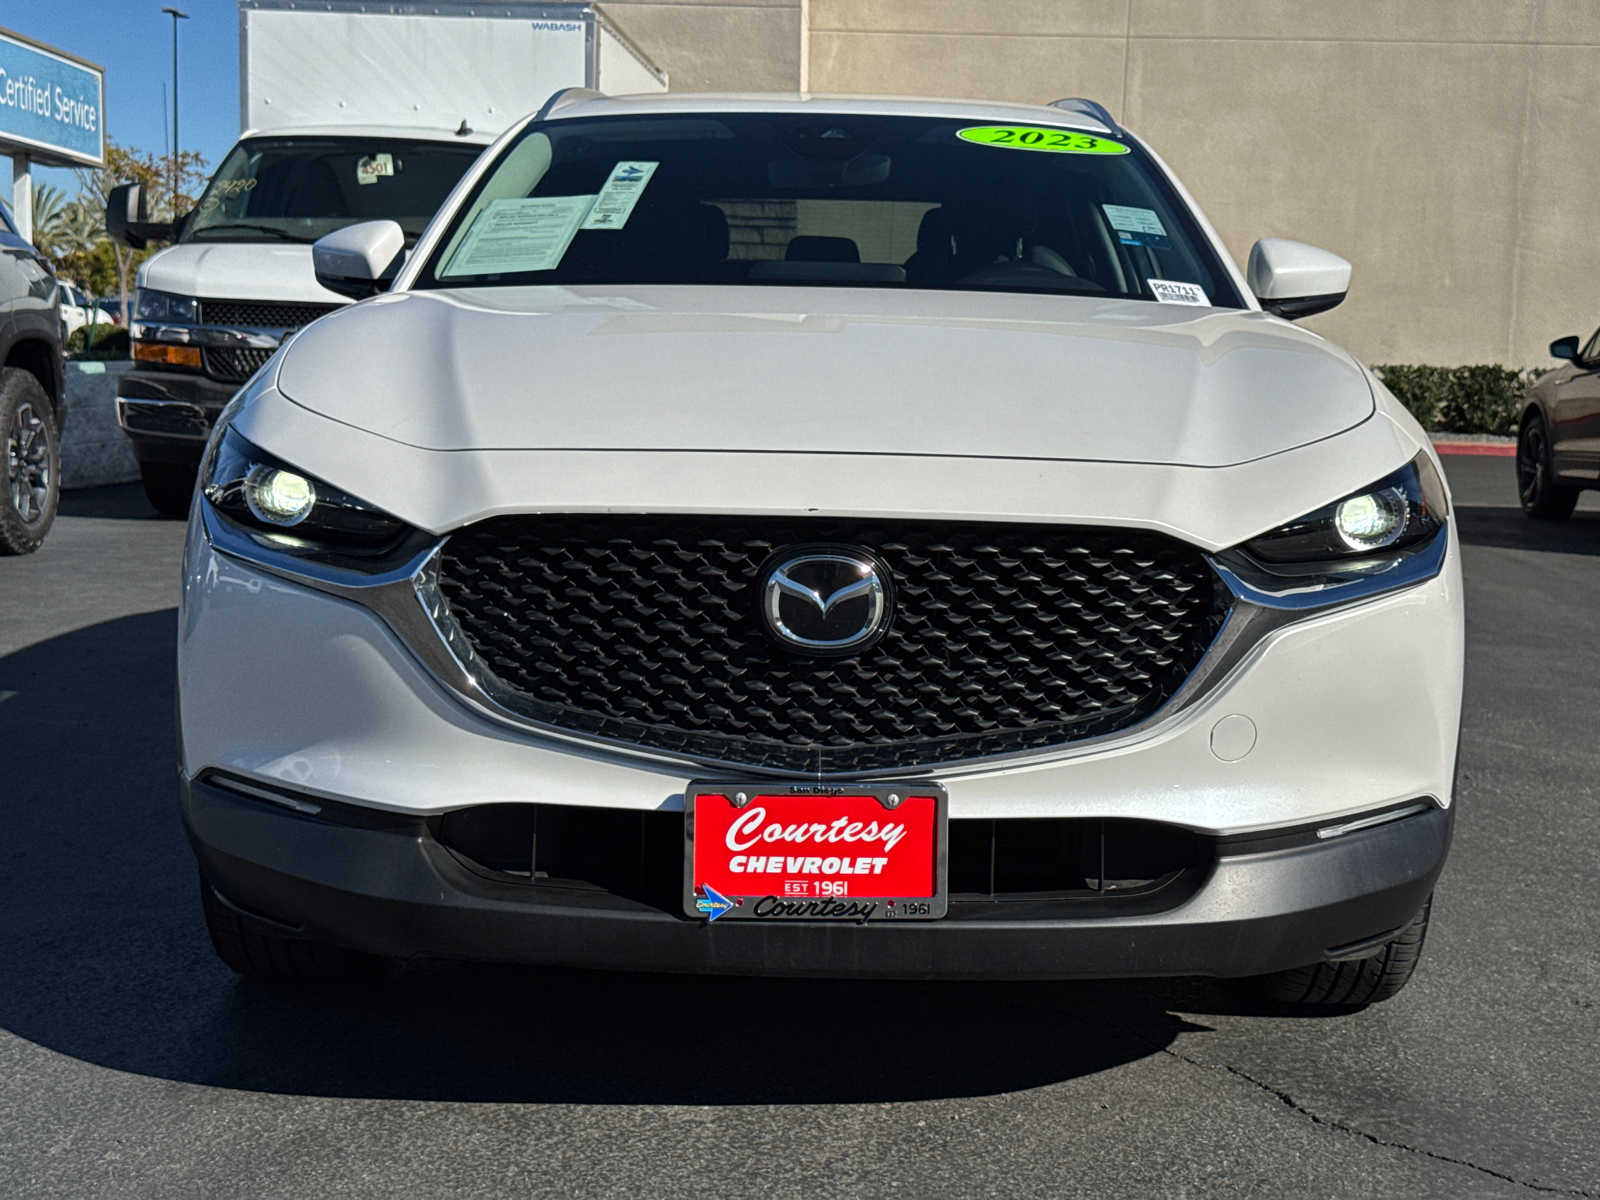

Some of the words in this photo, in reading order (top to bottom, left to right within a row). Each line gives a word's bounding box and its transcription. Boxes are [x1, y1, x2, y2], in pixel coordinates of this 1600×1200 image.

[531, 22, 582, 32] WABASH
[0, 67, 51, 118] Certified
[55, 86, 97, 133] Service
[990, 129, 1099, 150] 2023
[789, 786, 810, 794] San
[813, 786, 844, 796] Diego
[725, 807, 907, 853] Courtesy
[729, 855, 888, 875] CHEVROLET
[784, 883, 808, 892] EST
[813, 881, 848, 895] 1961
[753, 895, 880, 925] Courtesy
[902, 903, 930, 915] 1961
